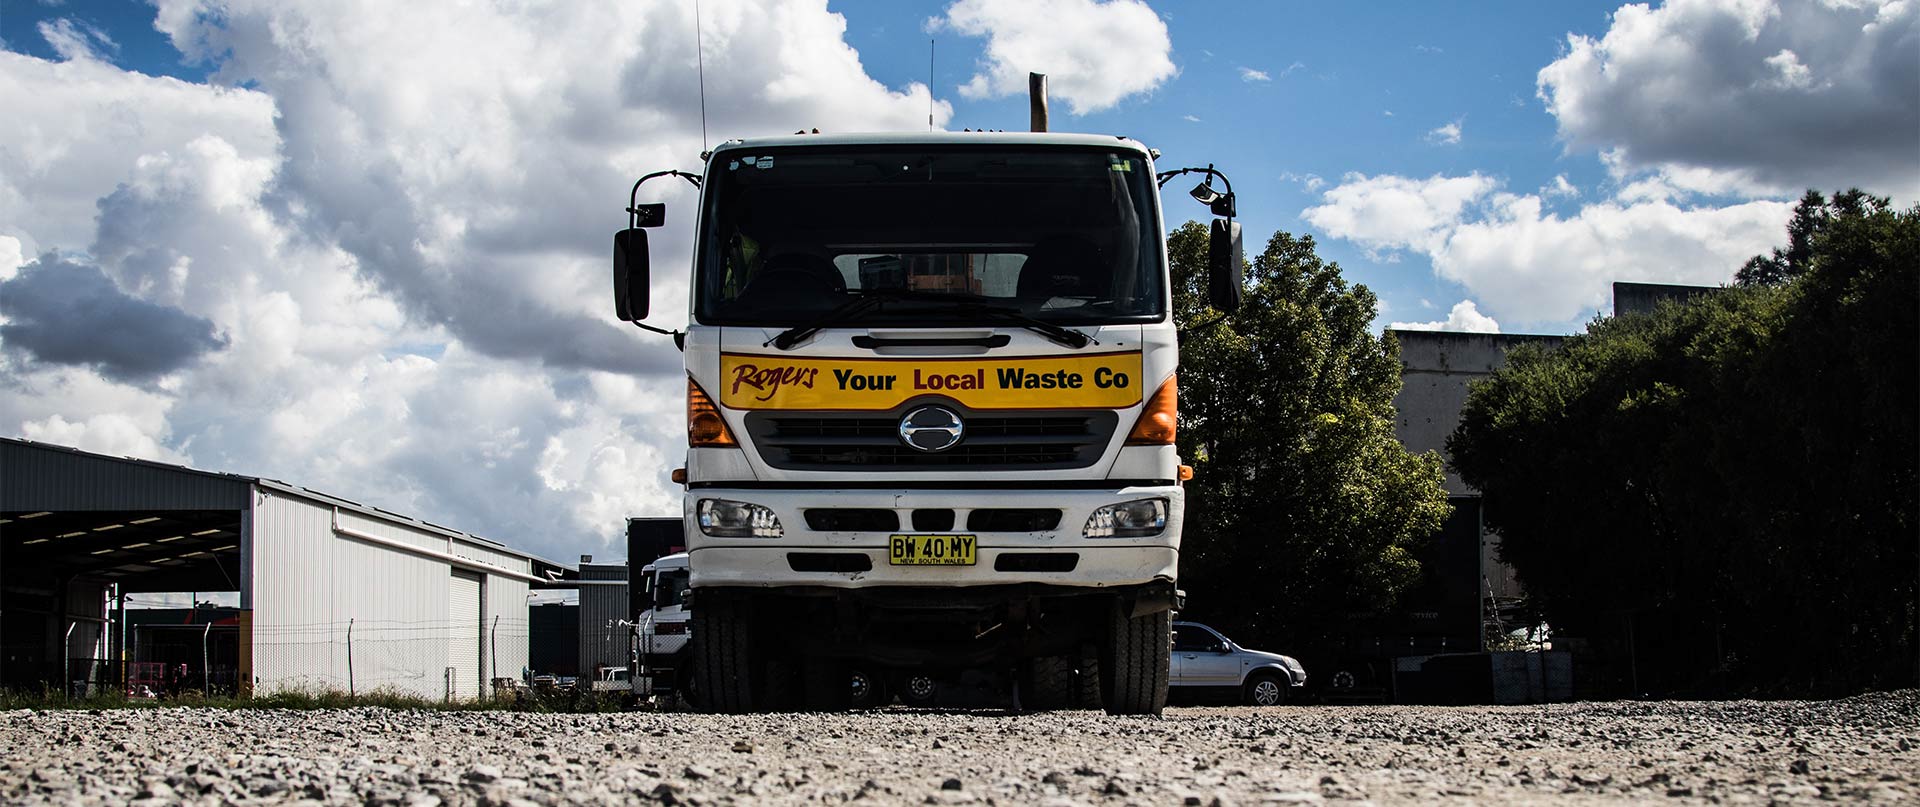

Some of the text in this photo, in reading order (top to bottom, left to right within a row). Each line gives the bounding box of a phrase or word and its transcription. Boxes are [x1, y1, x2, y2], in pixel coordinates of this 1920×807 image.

[732, 364, 1129, 401] Rogers Your Local Waste Co
